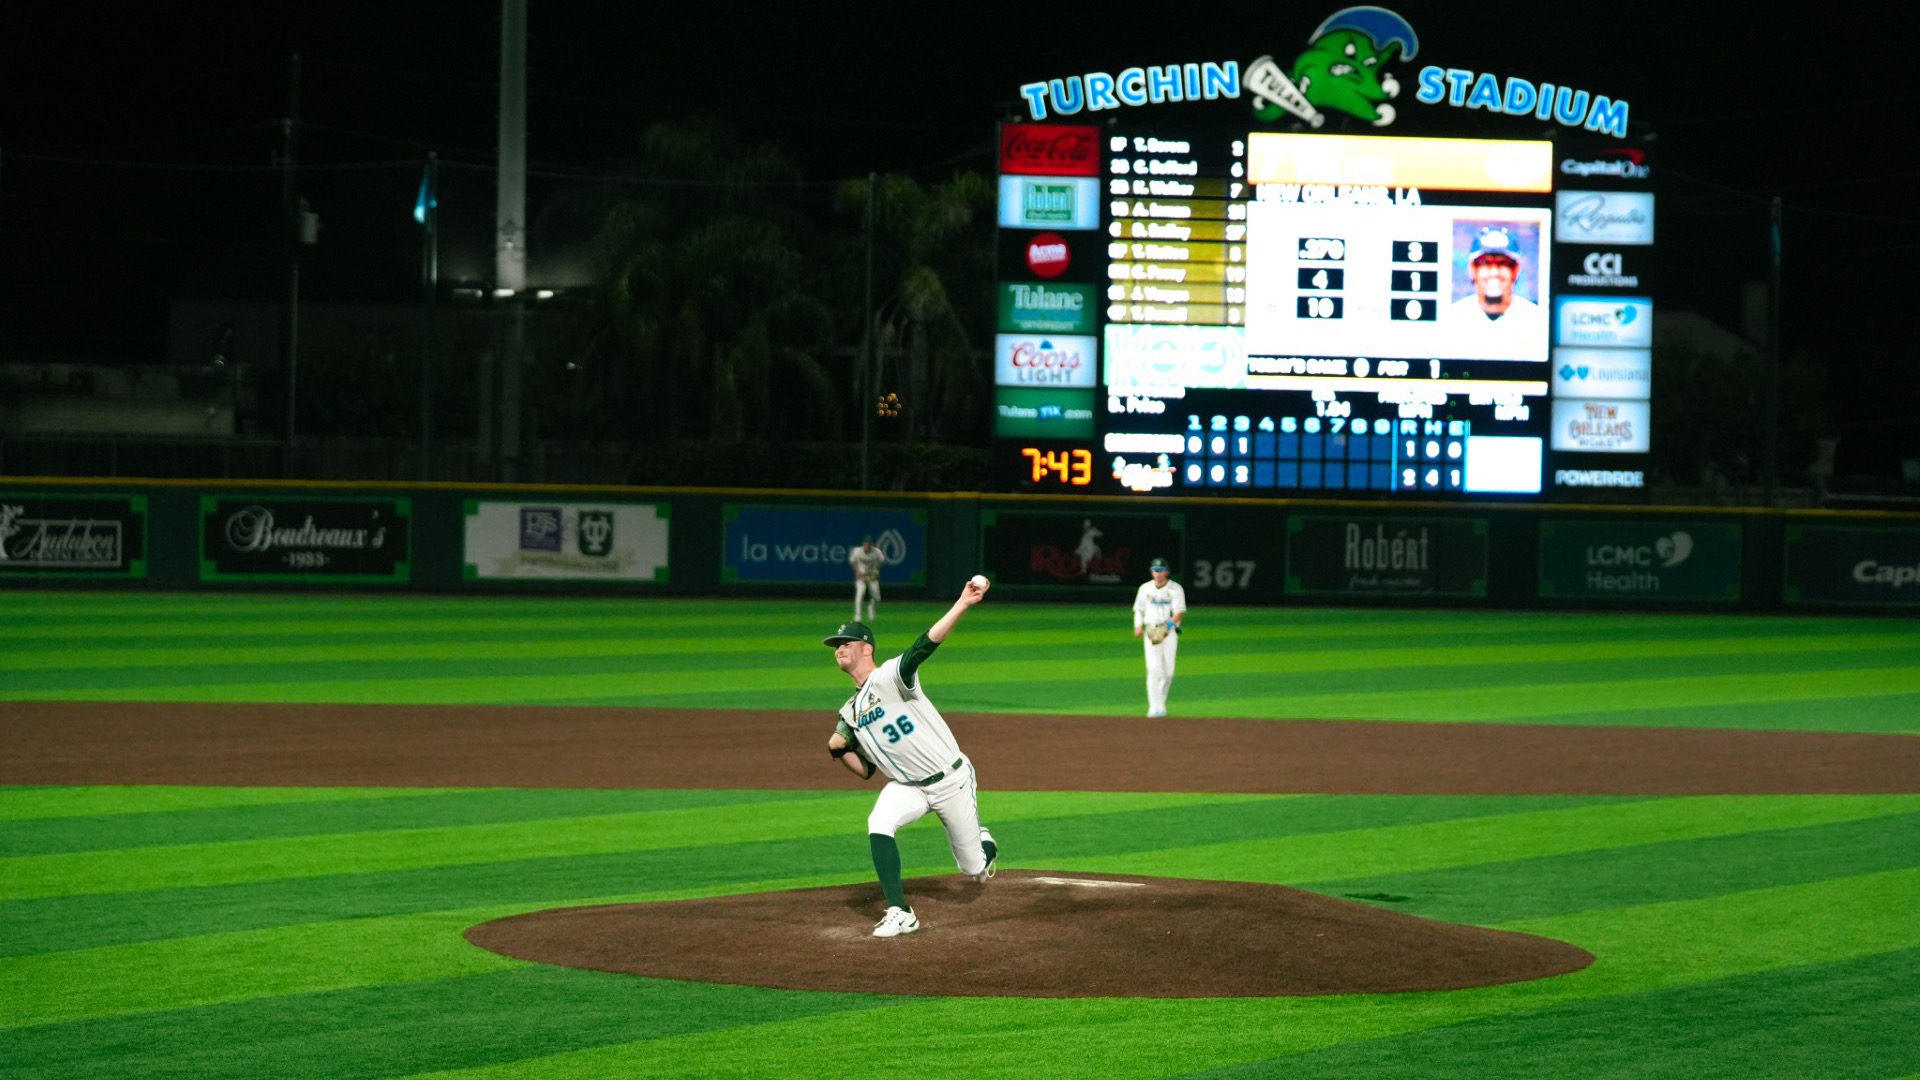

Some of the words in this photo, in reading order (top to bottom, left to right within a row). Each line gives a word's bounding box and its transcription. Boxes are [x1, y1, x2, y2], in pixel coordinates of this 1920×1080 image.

[1020, 61, 1240, 120] TURCHIN
[1416, 65, 1629, 138] STADIUM
[1584, 253, 1622, 275] CCI
[1009, 284, 1084, 311] Tulane
[1308, 297, 1334, 318] 10
[1571, 313, 1611, 326] LCMC
[1012, 342, 1082, 369] Coors
[1017, 368, 1073, 384] LIGHT
[1430, 359, 1440, 379] 1
[1188, 415, 1202, 431] 1
[1211, 415, 1228, 431] 2
[1234, 415, 1250, 432] 3
[1259, 417, 1274, 432] 4
[1281, 417, 1297, 433] 5
[1304, 417, 1321, 433] 6
[1330, 418, 1345, 433] 7
[1351, 418, 1368, 434] 8
[1401, 419, 1417, 435] R
[1424, 420, 1442, 435] H
[1448, 420, 1463, 436] E
[1188, 436, 1202, 453] 0
[1211, 436, 1226, 454] 0
[1238, 437, 1248, 454] 1
[1405, 440, 1415, 457] 1
[1425, 441, 1440, 458] 0
[1447, 441, 1462, 459] 0
[1021, 448, 1092, 485] 7:43
[1187, 464, 1202, 482] 0
[1210, 464, 1225, 482] 0
[1425, 469, 1439, 487] 4
[1450, 469, 1460, 487] 1
[1555, 470, 1644, 487] POWERADE
[226, 505, 386, 552] Boudreaux's
[743, 535, 767, 562] la
[776, 540, 852, 563] wate
[1587, 545, 1651, 566] LCMC
[1194, 561, 1256, 588] 367
[1587, 572, 1659, 591] Health
[857, 706, 885, 729] lane
[882, 715, 914, 743] 36
